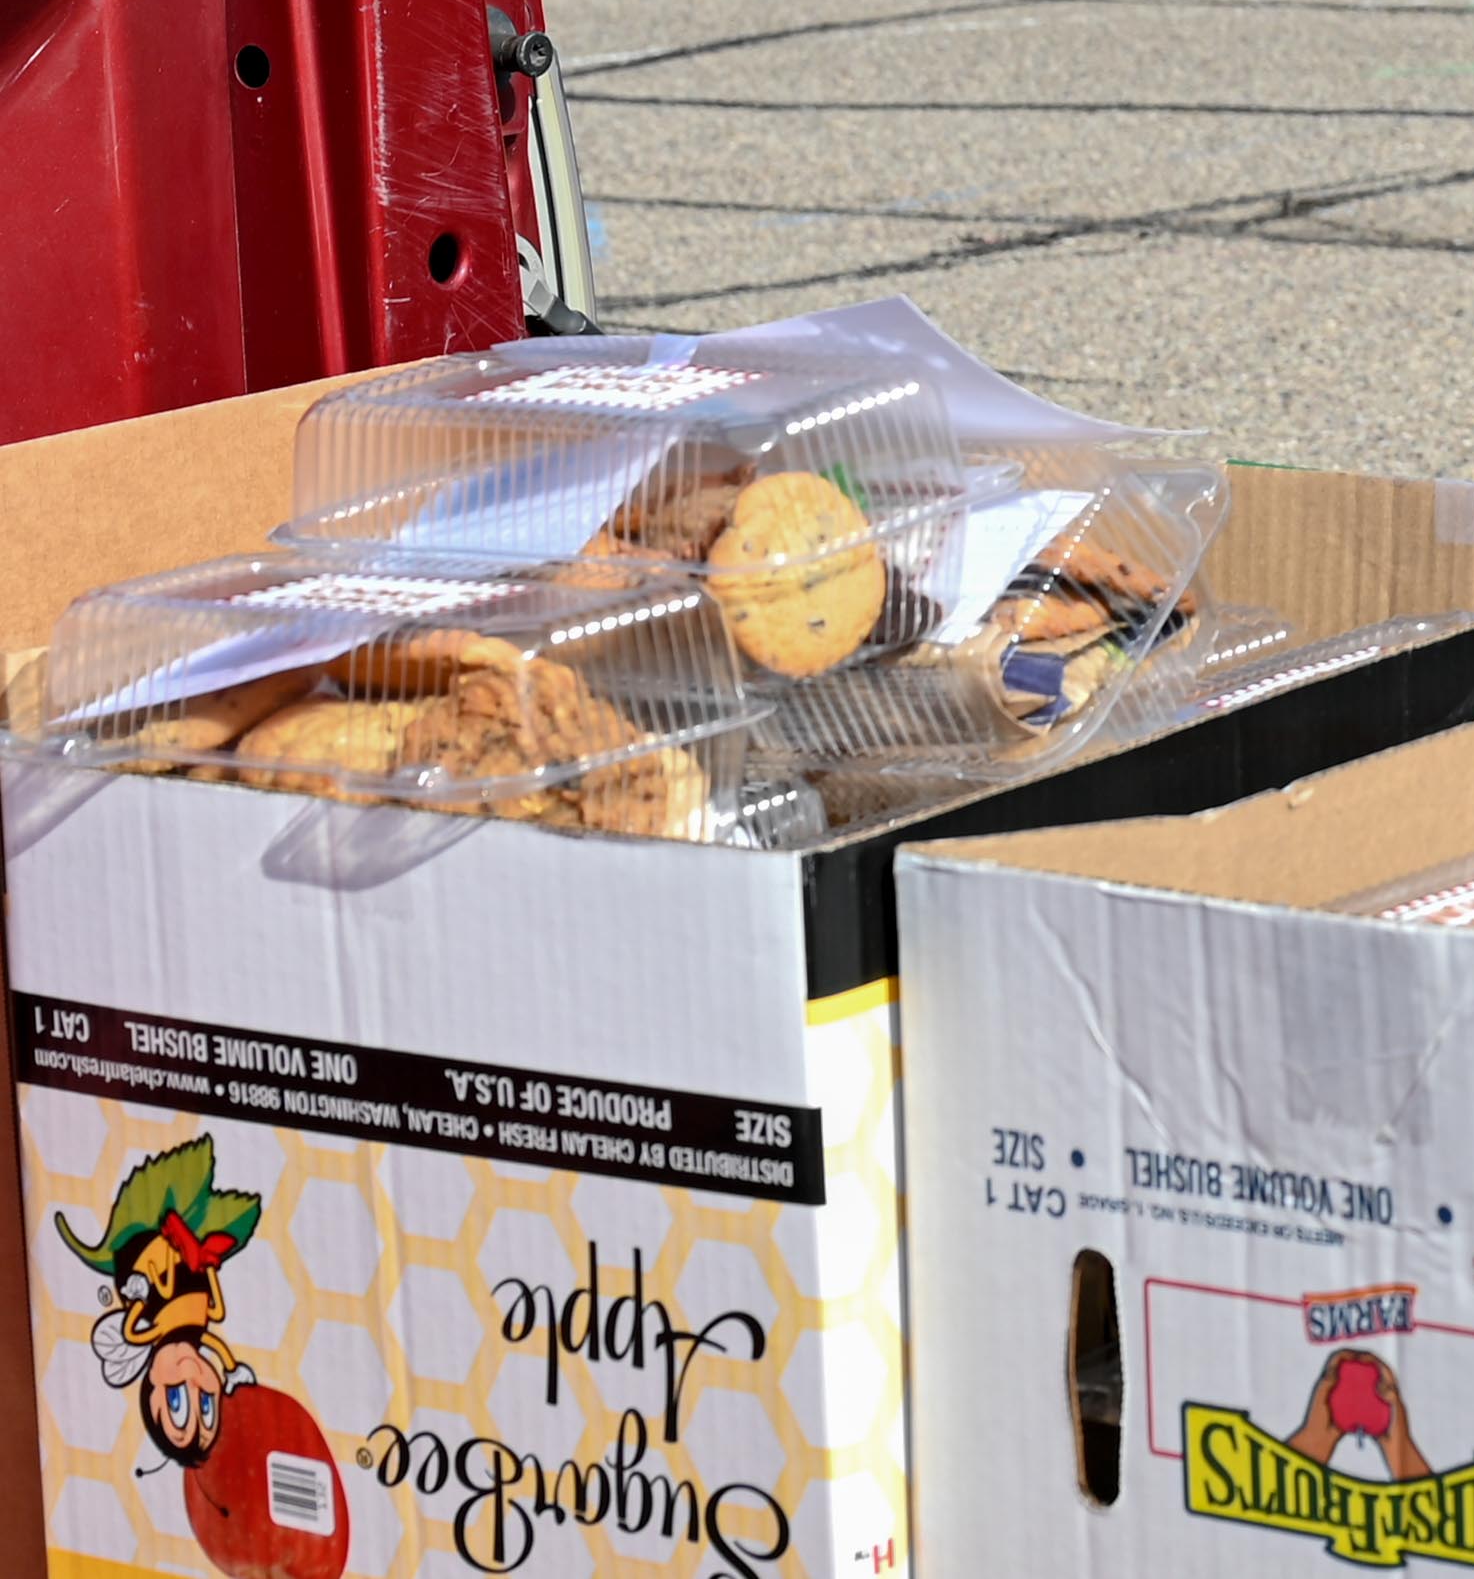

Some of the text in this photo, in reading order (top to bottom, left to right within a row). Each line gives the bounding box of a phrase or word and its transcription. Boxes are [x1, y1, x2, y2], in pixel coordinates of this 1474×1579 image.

[33, 1006, 793, 1149] SIZE PRODUCE OF U.S.A. ONE VOLUME BUSHEL CAT 1
[34, 1048, 211, 1096] www.chelanfresh.com
[228, 1080, 281, 1110] 98816
[284, 1089, 402, 1129] WASHINGTON
[498, 1120, 558, 1153] FRESH
[560, 1129, 635, 1165] CHELAN
[639, 1140, 666, 1169] BY
[993, 1128, 1046, 1172] SIZE
[668, 1145, 794, 1188] DISTRIBUTED
[1125, 1148, 1223, 1198] BUSHEL
[986, 1176, 1066, 1218] CAT 1
[1231, 1165, 1336, 1215] VOLUME
[1341, 1181, 1393, 1226] ONE
[1309, 1293, 1414, 1341] FARMS
[491, 1240, 766, 1444] Apple
